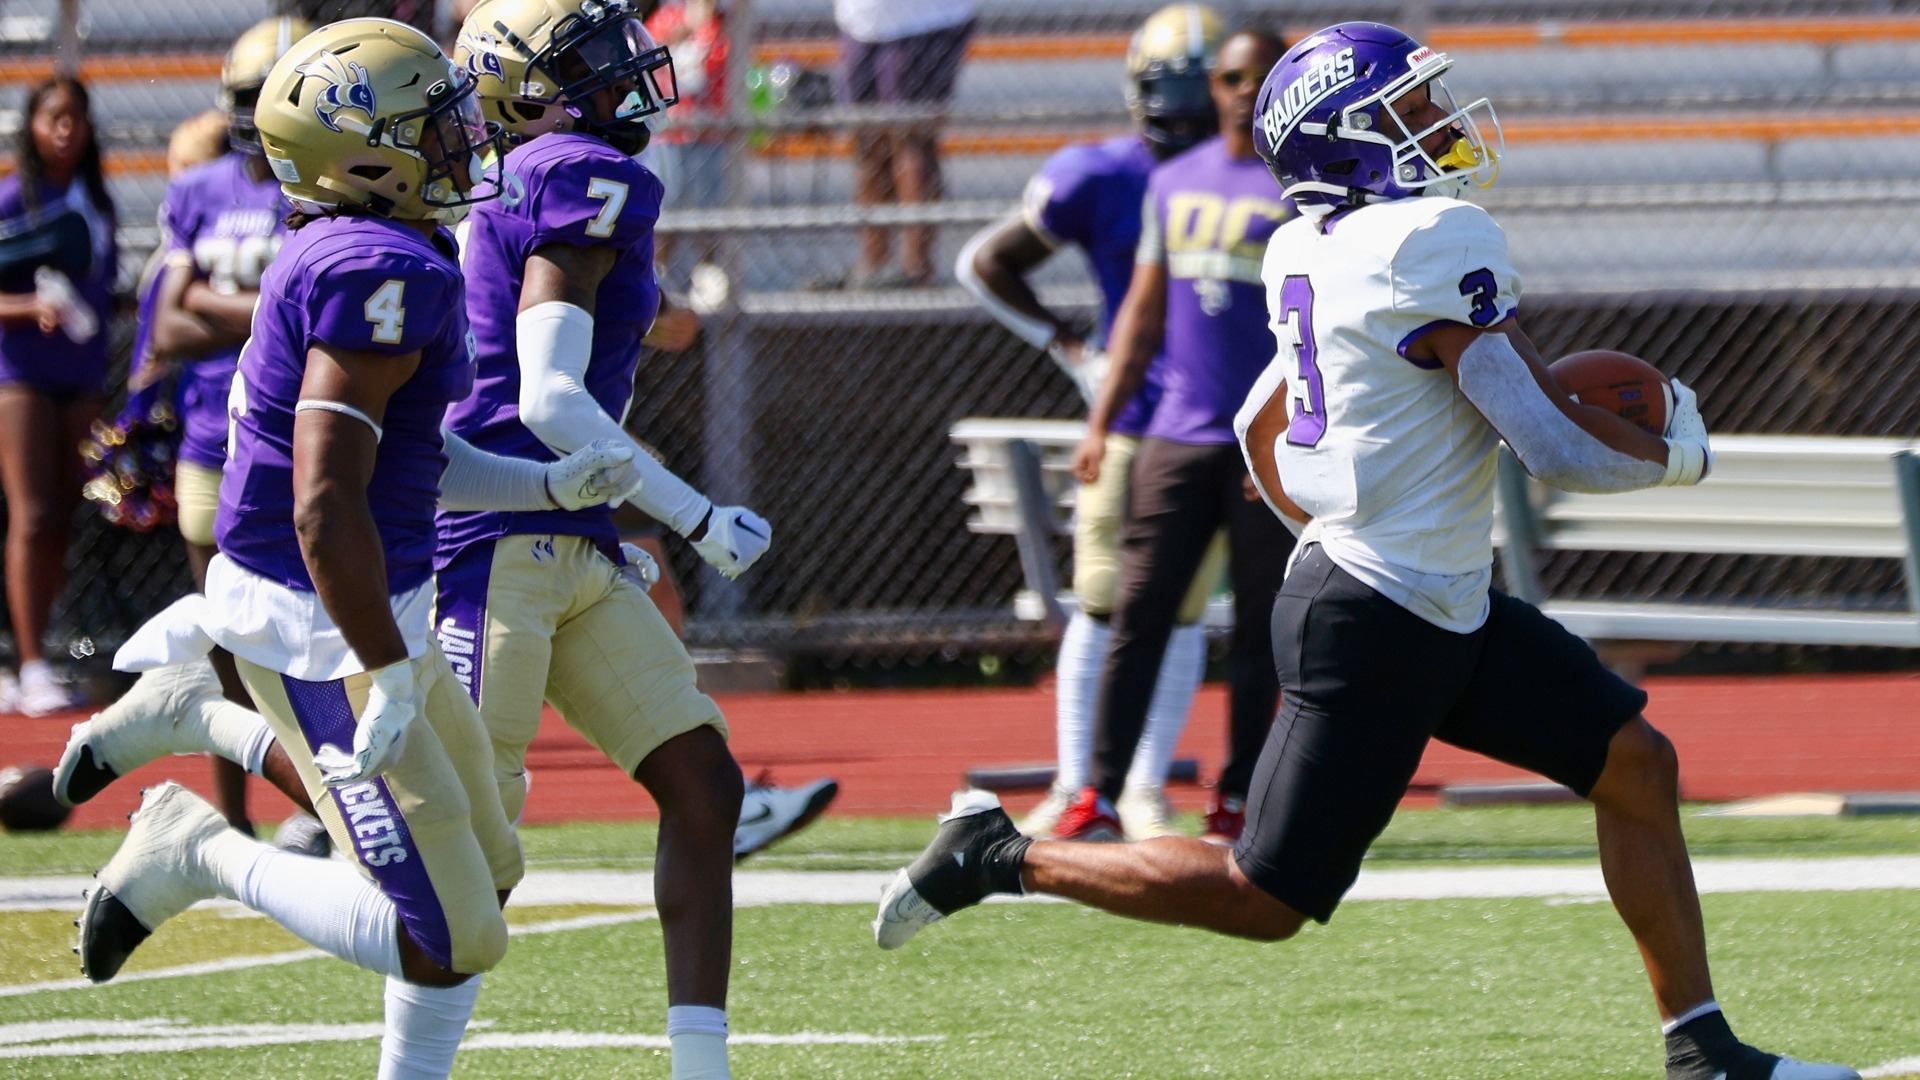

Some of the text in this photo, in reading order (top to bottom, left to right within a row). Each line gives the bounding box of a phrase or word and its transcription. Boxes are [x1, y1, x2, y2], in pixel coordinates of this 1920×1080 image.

[1263, 47, 1356, 150] RAIDERS
[584, 176, 630, 239] 7
[1166, 192, 1288, 256] DC
[364, 279, 406, 345] 4
[1458, 267, 1500, 328] 3
[1278, 274, 1327, 449] 3
[335, 781, 408, 867] CKETS
